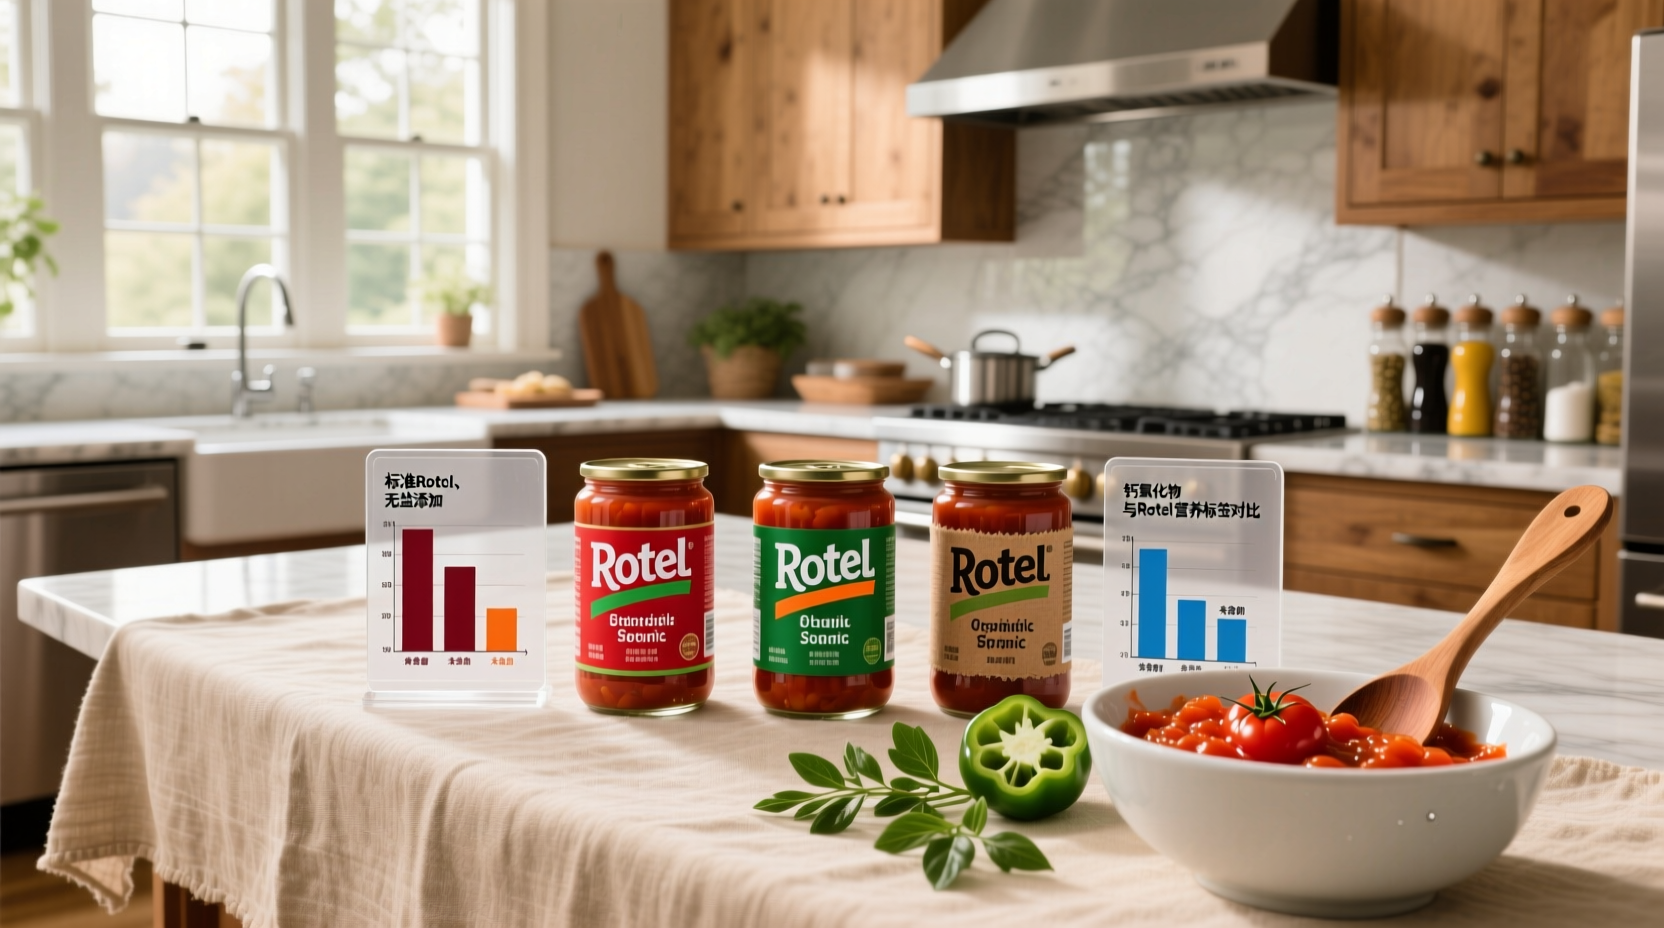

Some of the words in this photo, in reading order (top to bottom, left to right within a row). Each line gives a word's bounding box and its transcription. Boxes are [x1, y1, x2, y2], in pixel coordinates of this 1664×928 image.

[590, 536, 692, 592] Rotel
[774, 538, 876, 593] Rotel
[950, 544, 1051, 597] Rotel
